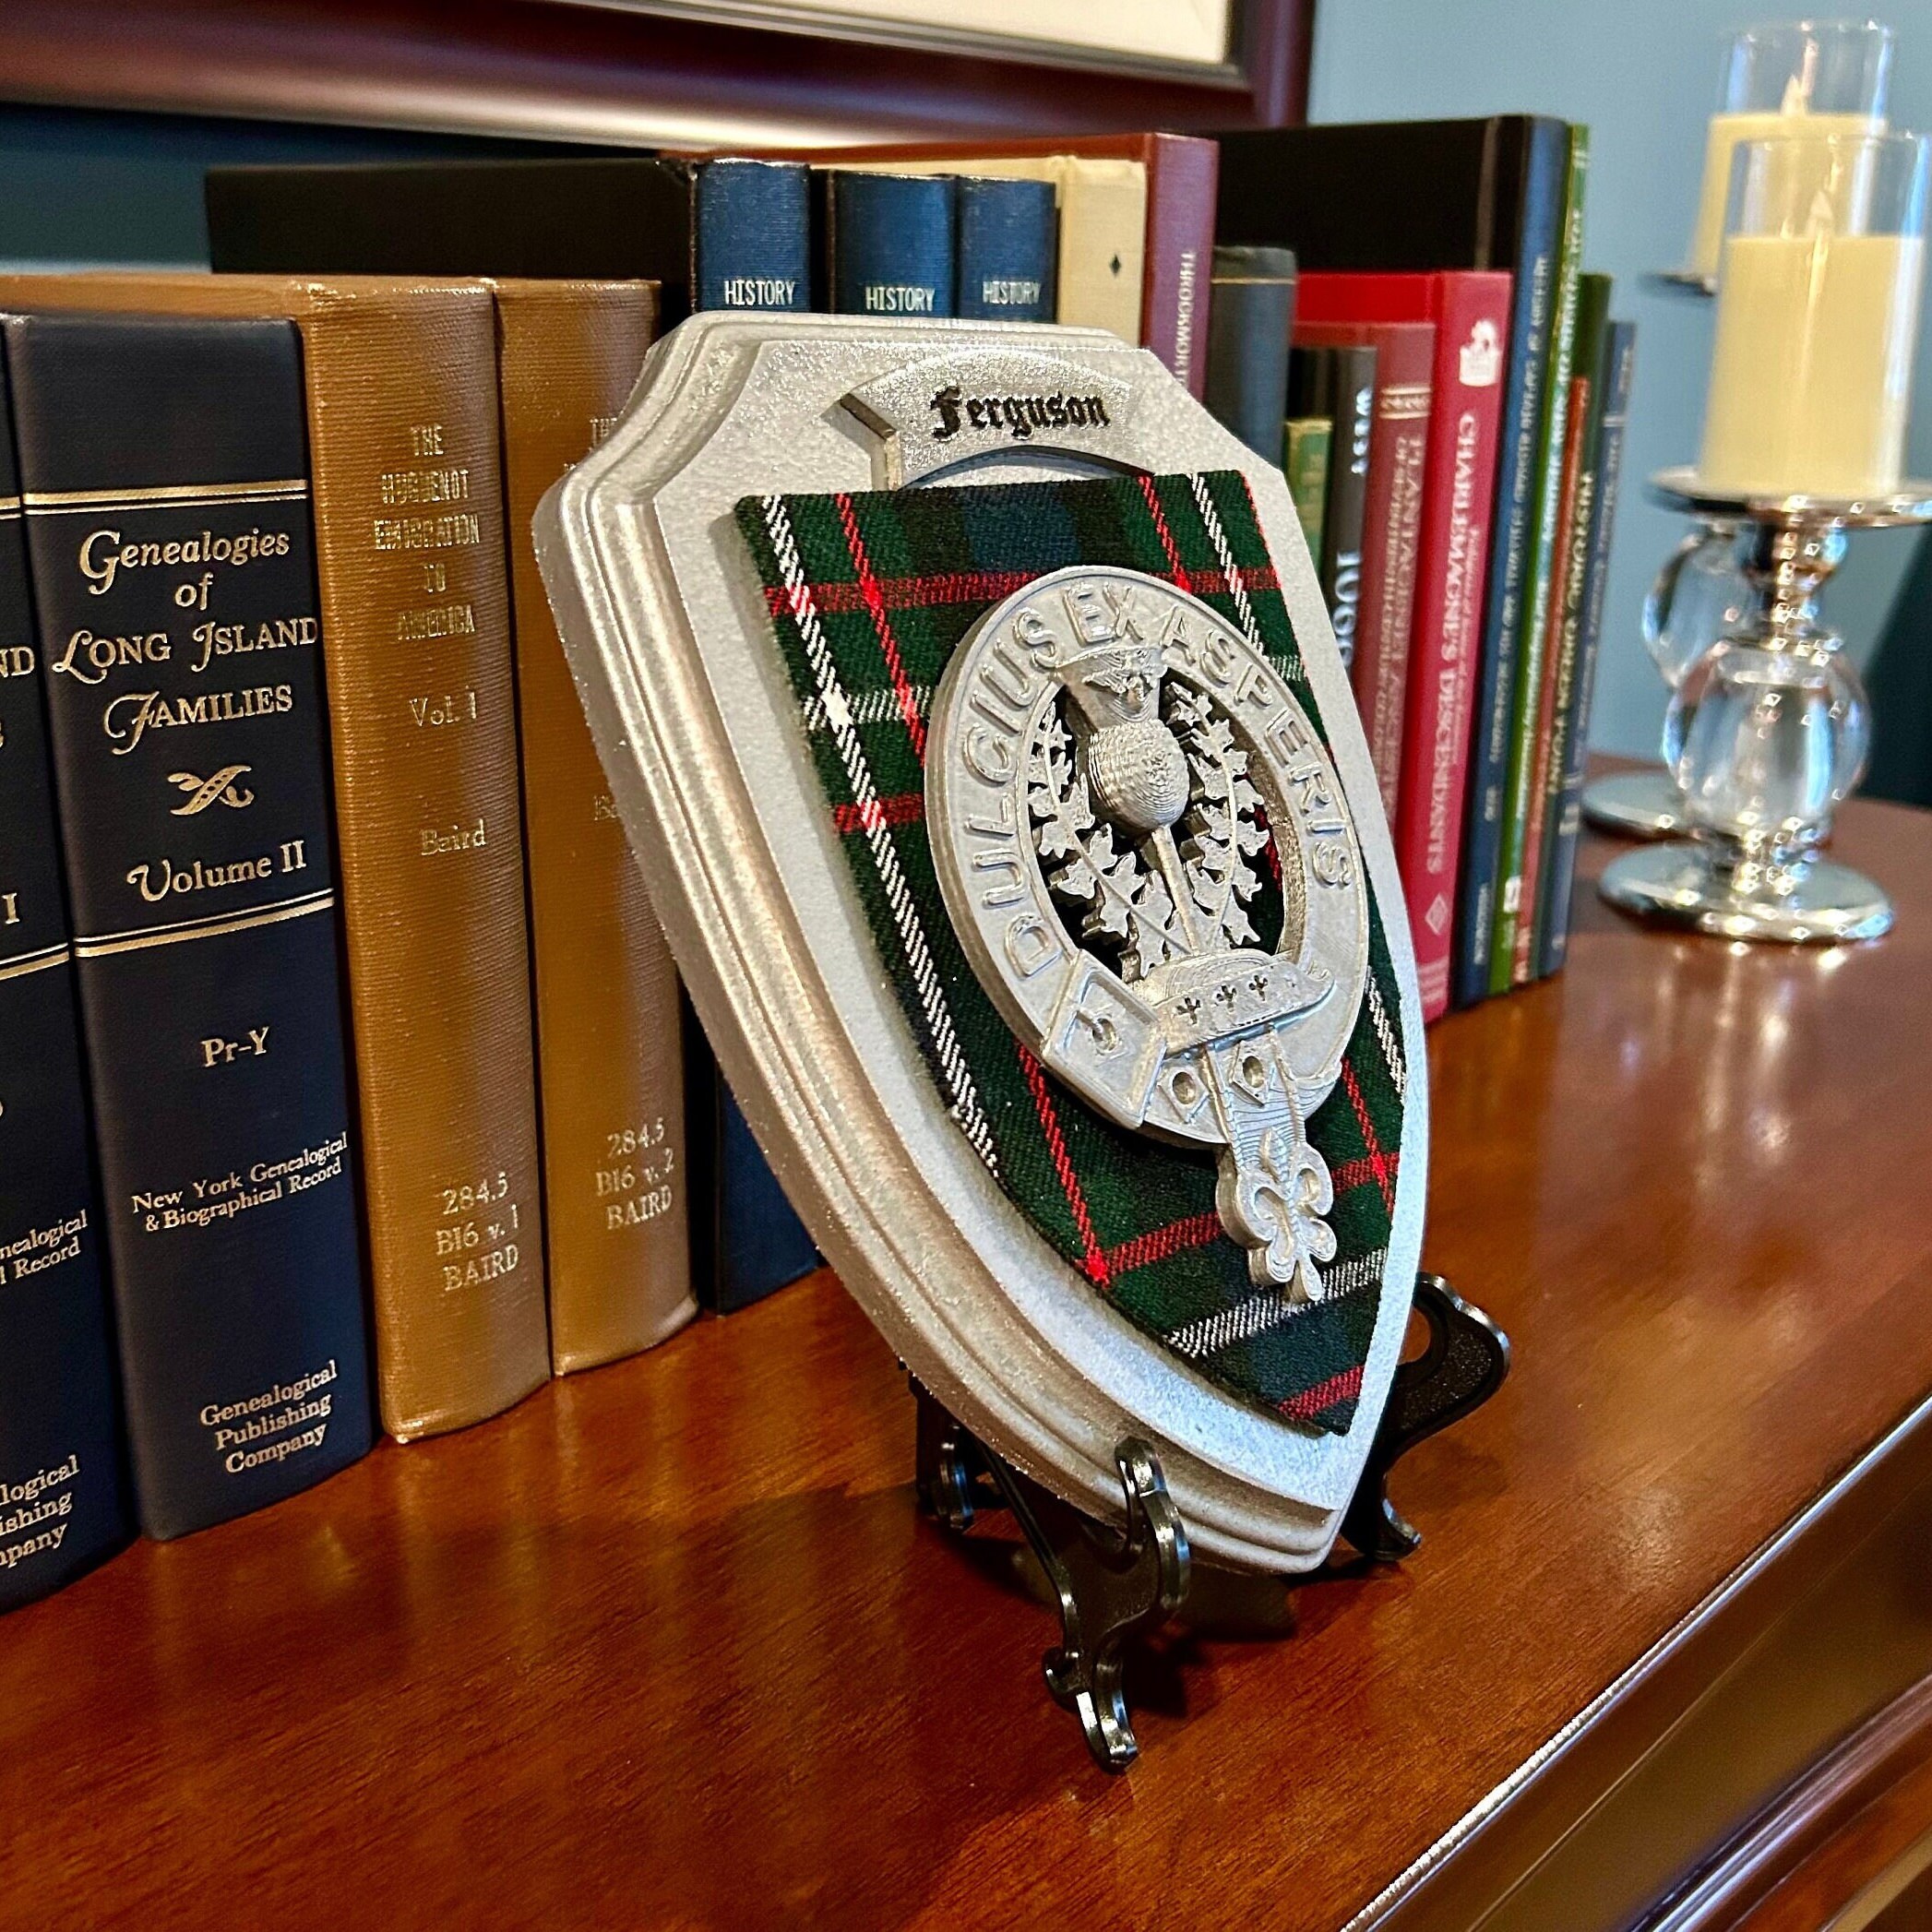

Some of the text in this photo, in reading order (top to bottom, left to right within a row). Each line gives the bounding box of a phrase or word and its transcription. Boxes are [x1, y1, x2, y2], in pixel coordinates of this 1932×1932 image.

[724, 280, 795, 307] HISTORY
[865, 285, 936, 315] HISTORY
[982, 280, 1042, 305] HISTORY
[930, 380, 1111, 442] Ferguson
[411, 423, 444, 457] THE
[79, 528, 290, 595] Genealogies
[174, 572, 213, 611] of
[52, 630, 172, 685] LONG
[191, 616, 318, 672] ISLAND
[1426, 412, 1476, 875] CHARLEMAGNE'S DESCENDANTS
[103, 684, 293, 756] FAMILIES
[1064, 582, 1144, 647] EX
[1159, 602, 1354, 889] ASPERIS
[421, 818, 487, 856] Baird
[126, 840, 307, 902] Volume II
[2, 892, 20, 924] I
[200, 1026, 269, 1068] Pr-Y
[607, 1116, 665, 1160] 284.5
[664, 1147, 674, 1174] 2
[132, 1130, 349, 1214] New York Genealogical
[145, 1155, 342, 1234] & Biographical Record
[443, 1171, 508, 1216] 284.5
[606, 1185, 673, 1230] BAIRD
[487, 1222, 506, 1241] v.
[14, 1235, 81, 1280] Record
[443, 1244, 519, 1293] BAIRD
[199, 1359, 339, 1427] Genealogical
[214, 1393, 332, 1451] Publishing
[225, 1422, 328, 1475] Company
